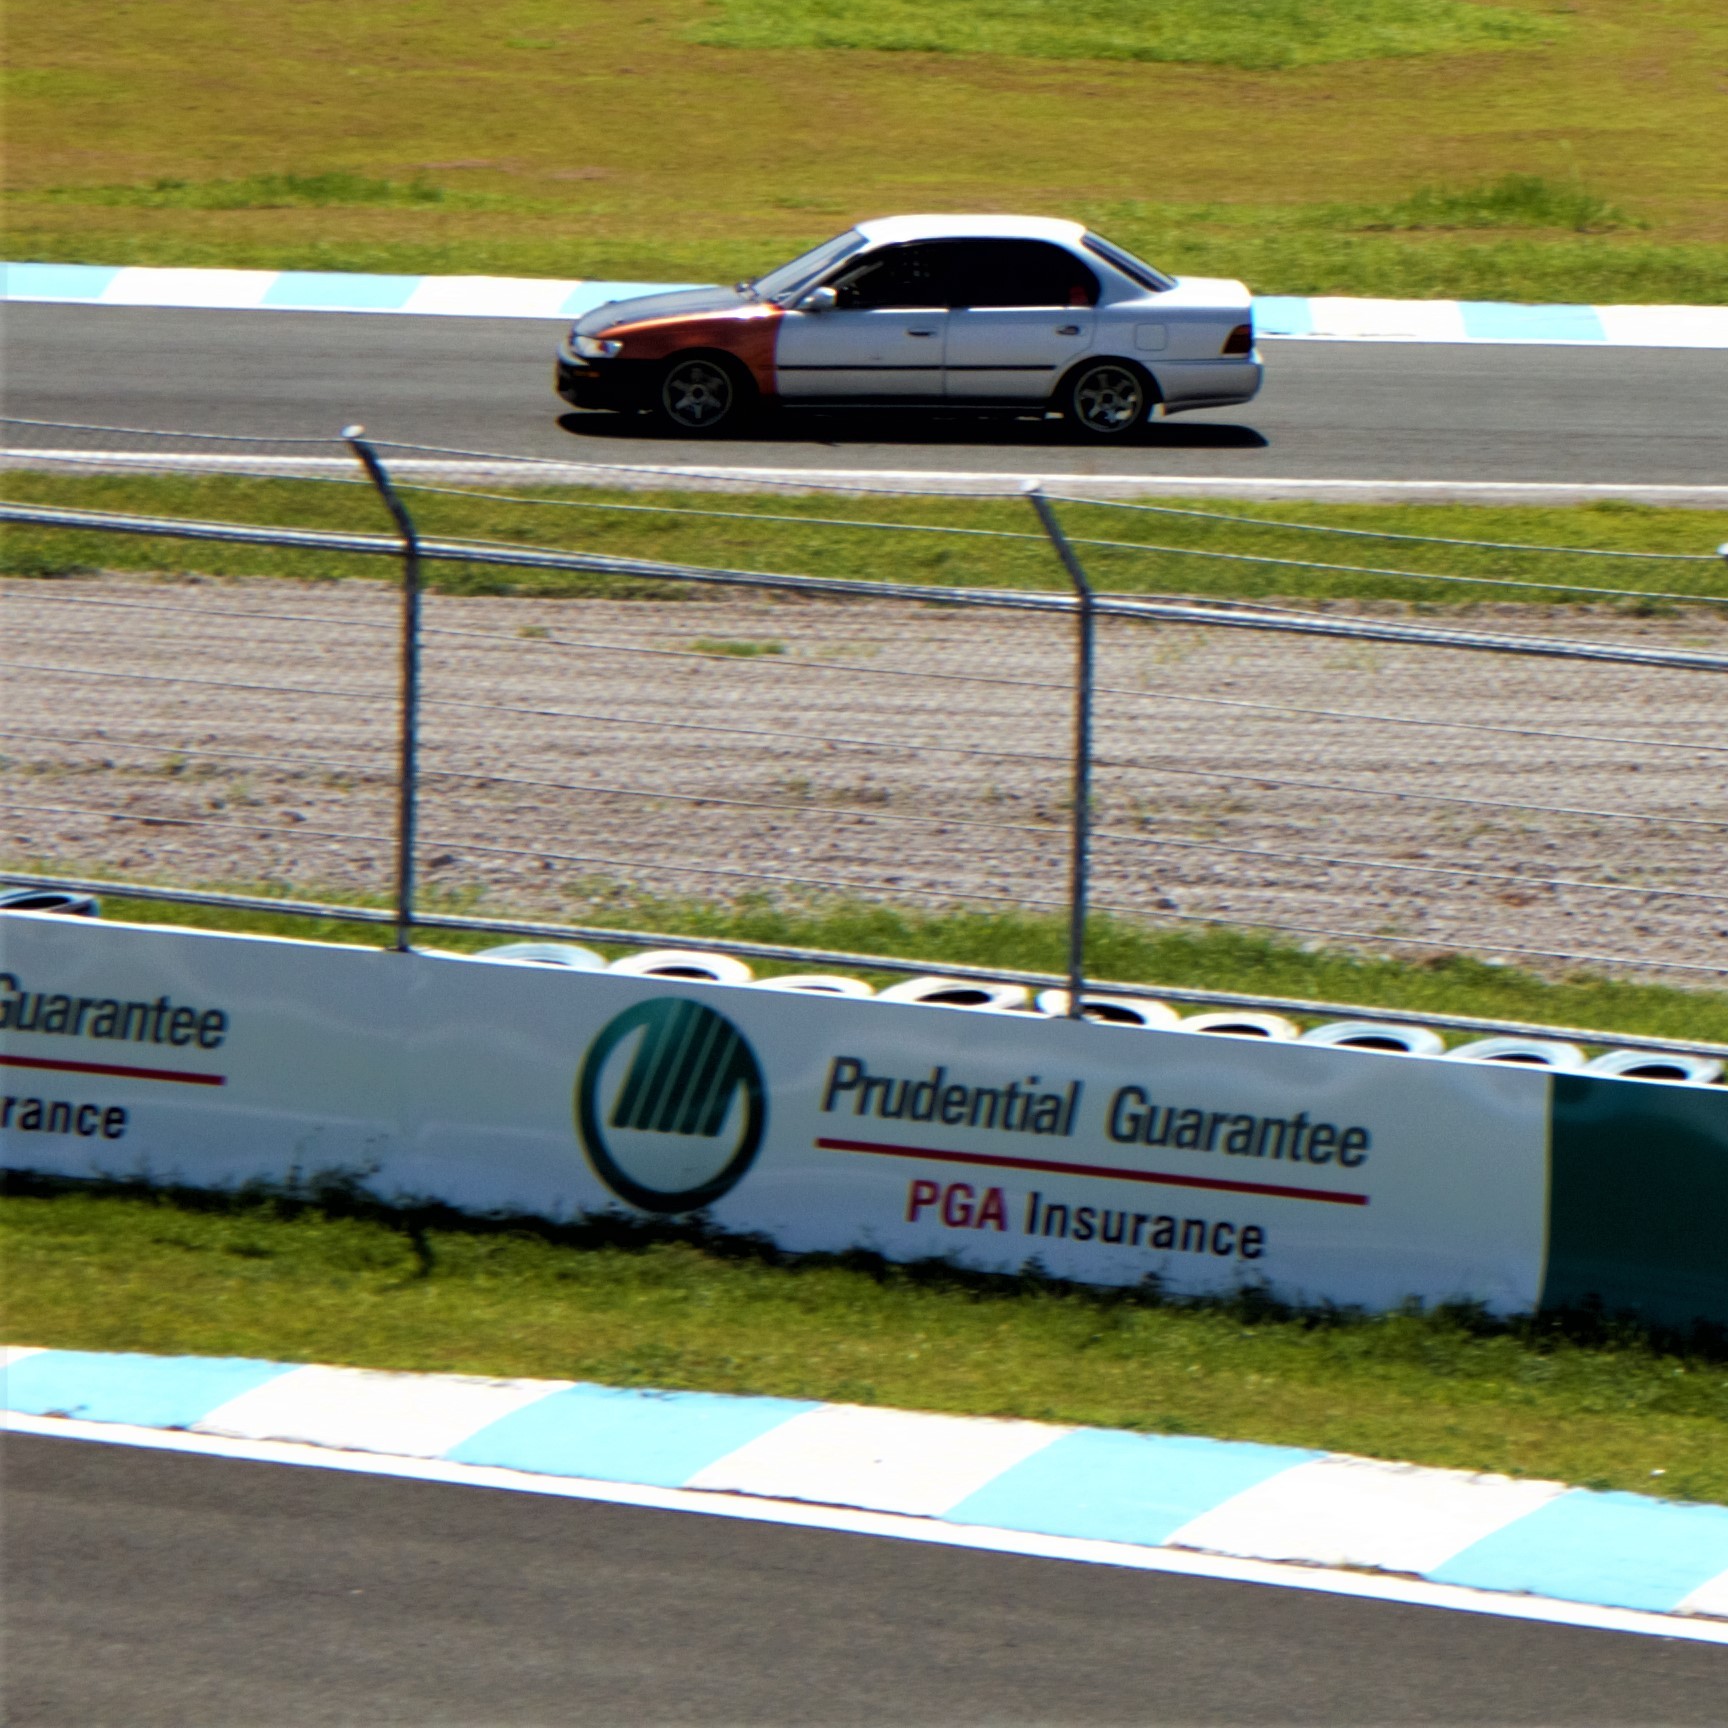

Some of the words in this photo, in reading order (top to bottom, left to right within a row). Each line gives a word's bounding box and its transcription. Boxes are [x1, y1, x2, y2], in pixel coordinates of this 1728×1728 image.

[821, 1056, 1083, 1138] Prudential
[1106, 1085, 1370, 1167] Guarantee
[907, 1179, 1008, 1232] PGA
[1025, 1191, 1265, 1259] Insurance
